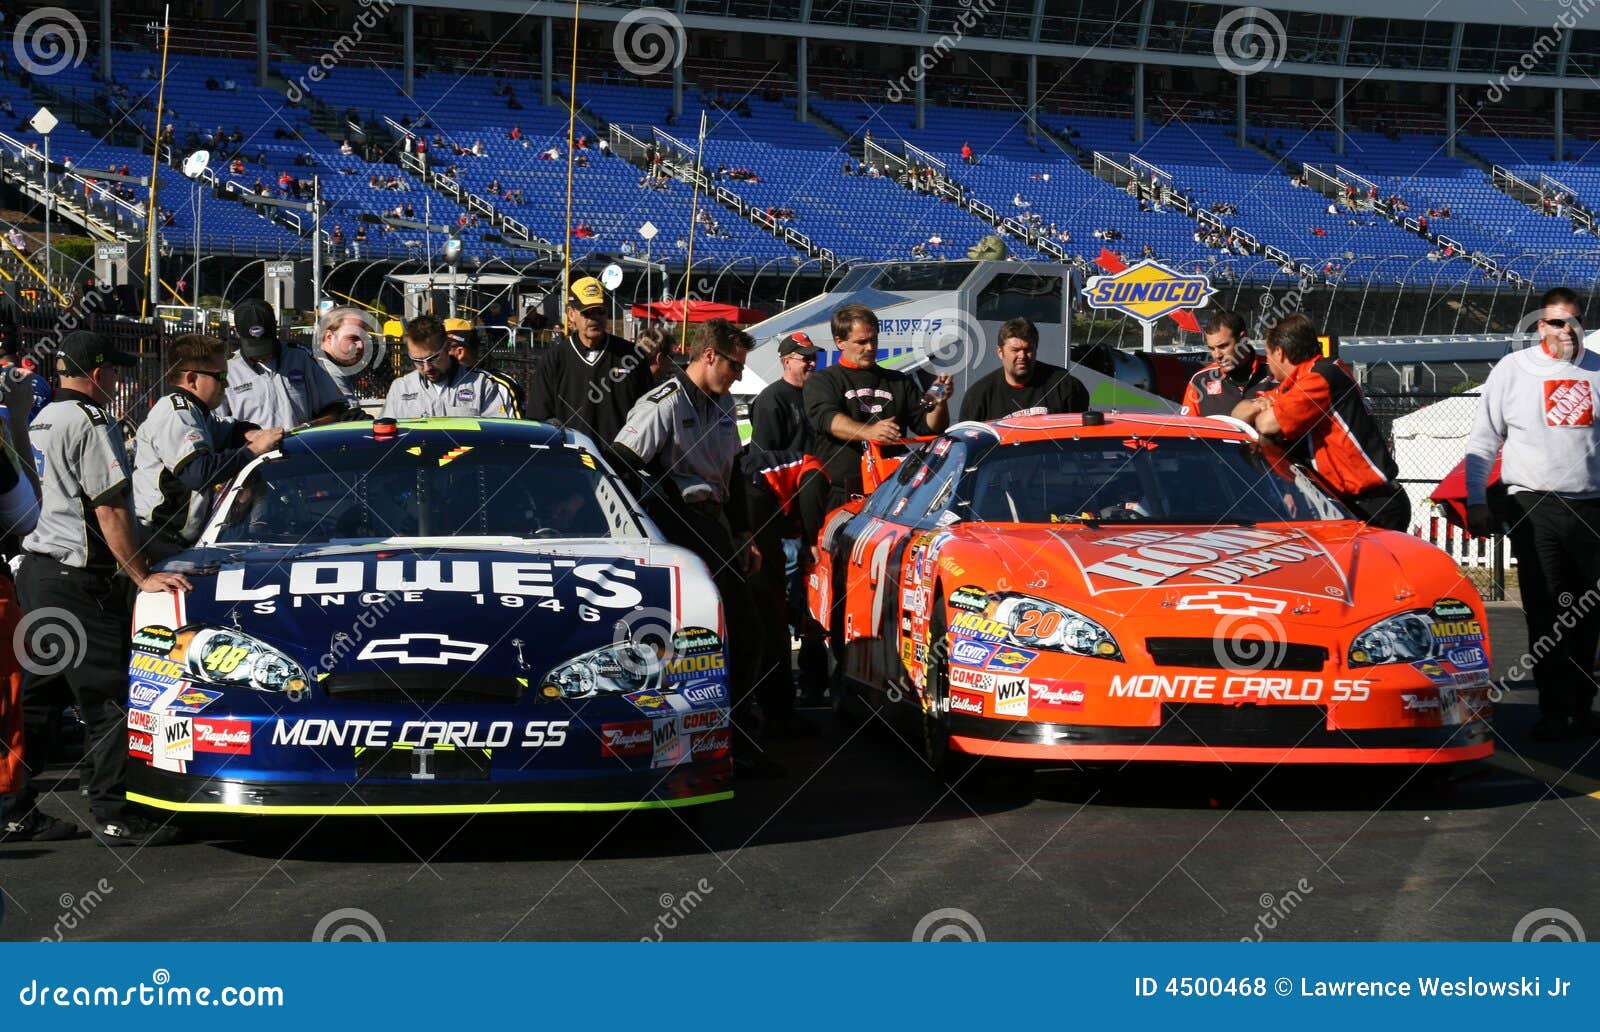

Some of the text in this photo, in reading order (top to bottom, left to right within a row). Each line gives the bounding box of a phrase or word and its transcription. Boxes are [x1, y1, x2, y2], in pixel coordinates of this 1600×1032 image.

[1095, 282, 1202, 302] SUNOCO
[1547, 380, 1590, 425] HOME
[1549, 384, 1570, 404] THE
[1567, 397, 1593, 425] DEPOT
[1091, 529, 1184, 549] THE
[1084, 528, 1312, 586] HOME
[1189, 542, 1326, 584] DEPOT
[215, 560, 642, 610] LOWE'S
[253, 591, 601, 622] SINCE 1946
[952, 611, 1011, 637] MOOG
[1014, 609, 1062, 639] 20
[1431, 621, 1481, 637] MOOG
[131, 653, 187, 679] MOOG
[204, 644, 249, 673] 48
[665, 653, 725, 674] MOOG
[952, 669, 983, 685] COMP
[998, 680, 1026, 700] WIX
[1108, 675, 1371, 702] MONTE CARLO SS
[684, 684, 724, 702] CLEVITE
[130, 711, 151, 726] COMP
[165, 720, 190, 743] WIX
[683, 710, 718, 729] COMP
[271, 718, 570, 748] MONTE CARLO SS
[654, 718, 677, 746] WIX
